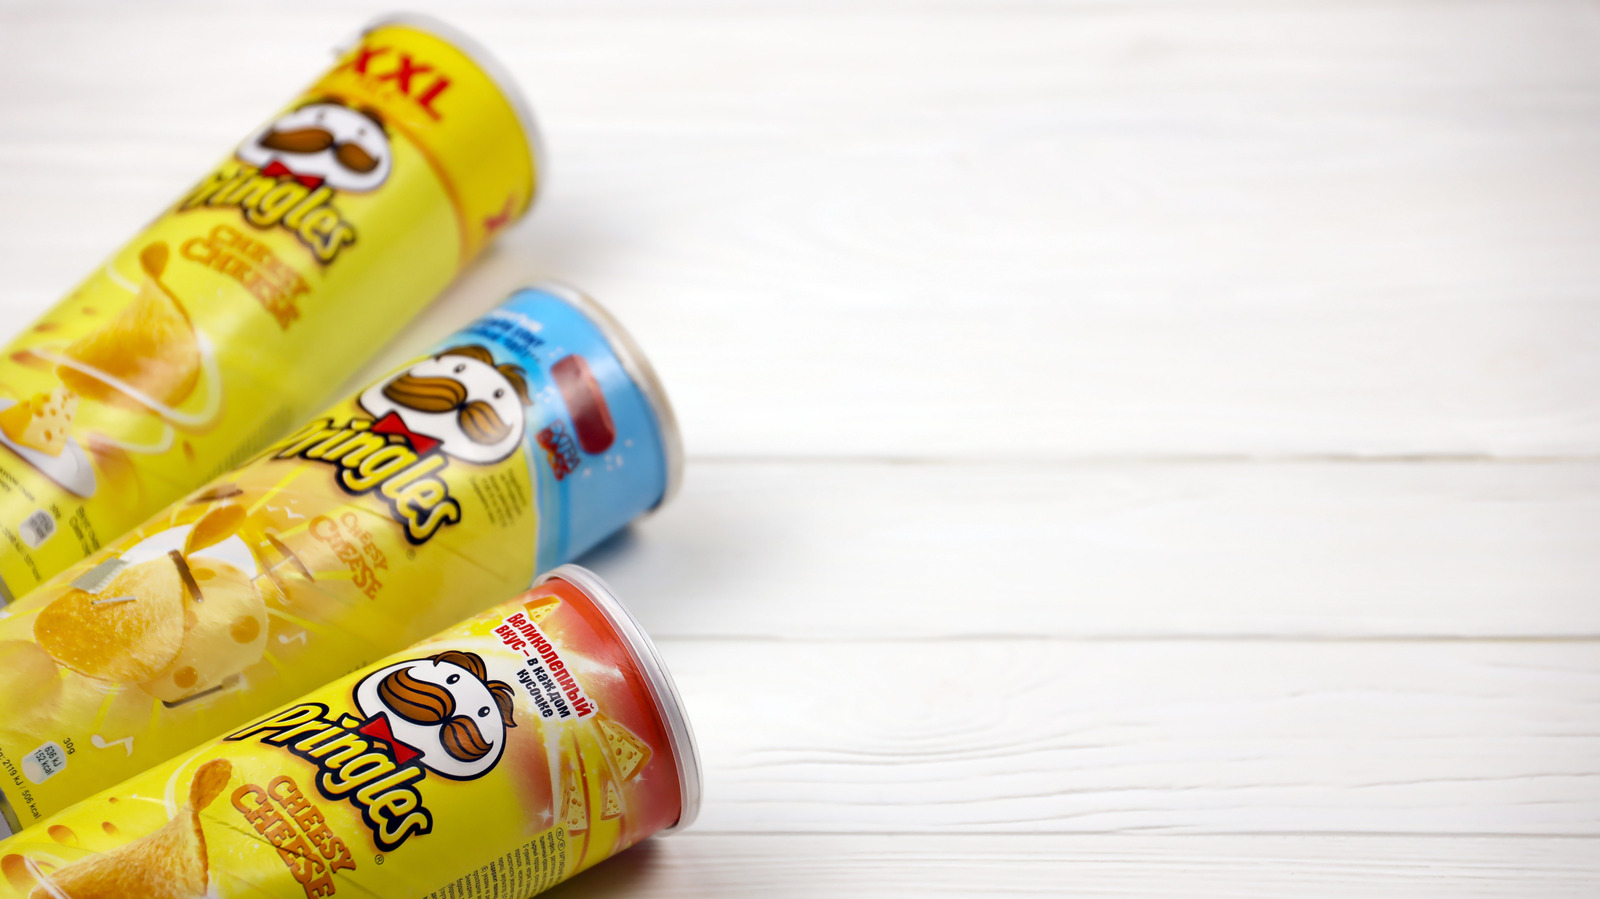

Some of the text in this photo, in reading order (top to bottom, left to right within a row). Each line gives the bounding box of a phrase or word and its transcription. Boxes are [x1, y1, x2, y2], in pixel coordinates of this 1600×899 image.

[336, 45, 453, 123] XXL
[175, 164, 358, 266] ringles
[308, 514, 383, 600] CHEESE
[340, 511, 388, 572] CHEESY
[494, 624, 526, 652] вкус
[506, 612, 594, 718] Великолепный
[527, 657, 539, 667] в
[516, 668, 554, 718] кусочке
[532, 666, 571, 719] каждом
[34, 749, 54, 775] 152 kcal
[44, 745, 63, 768] 636 kJ
[63, 737, 76, 755] 30g
[2, 759, 18, 777] 2119
[13, 774, 24, 786] kJ
[21, 789, 32, 804] 506
[30, 802, 42, 819] kcal
[223, 702, 433, 852] Pringles
[231, 784, 335, 899] CHEESE
[267, 775, 356, 873] CHEESY
